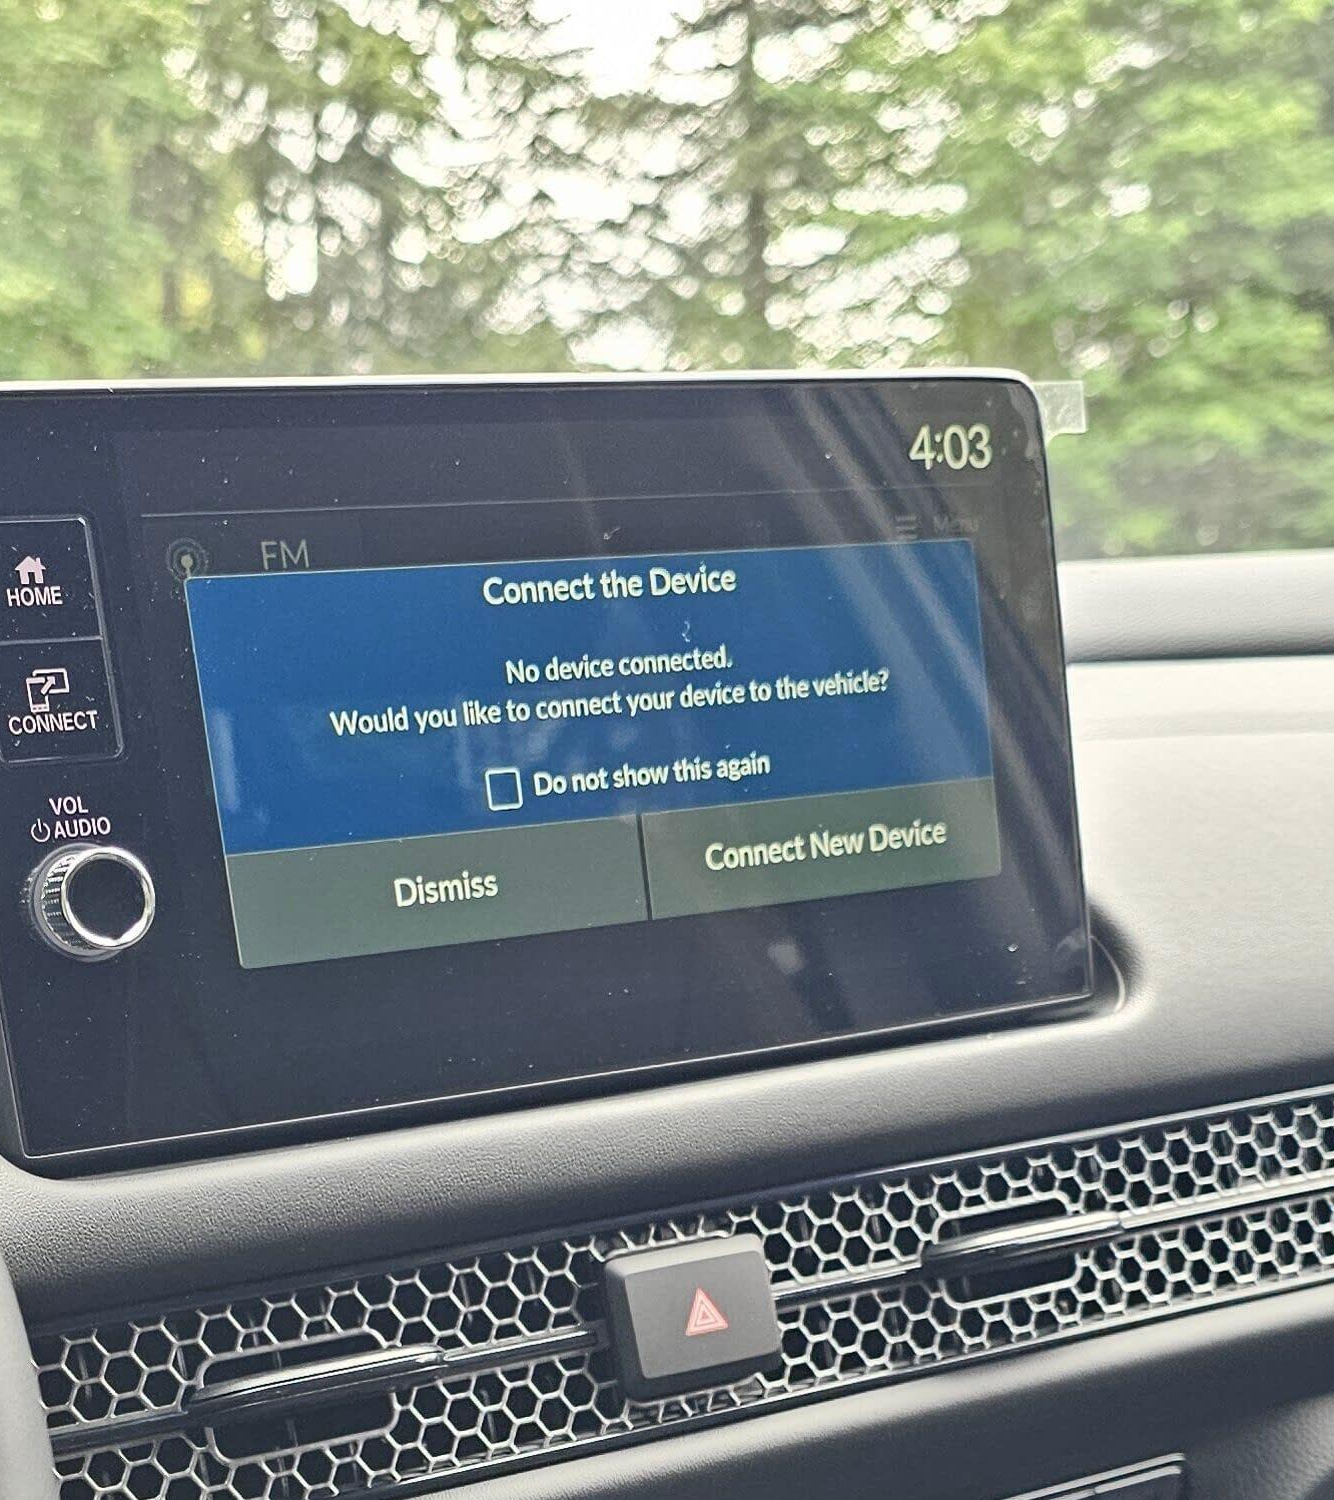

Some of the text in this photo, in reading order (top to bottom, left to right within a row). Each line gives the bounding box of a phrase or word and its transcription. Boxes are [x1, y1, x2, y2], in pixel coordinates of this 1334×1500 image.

[908, 423, 993, 470] 4:03
[260, 539, 310, 570] FM
[6, 585, 64, 607] HOME
[483, 565, 737, 606] Connect the Device
[505, 643, 733, 685] No device connected.
[329, 667, 890, 736] Would you like to connect your device to the vehicle?
[8, 709, 99, 735] CONNECT
[533, 752, 771, 797] Do not show this again
[49, 796, 89, 815] VOL
[54, 816, 111, 839] AUDIO
[704, 819, 948, 873] Connect New Device
[394, 871, 499, 907] Dismiss
